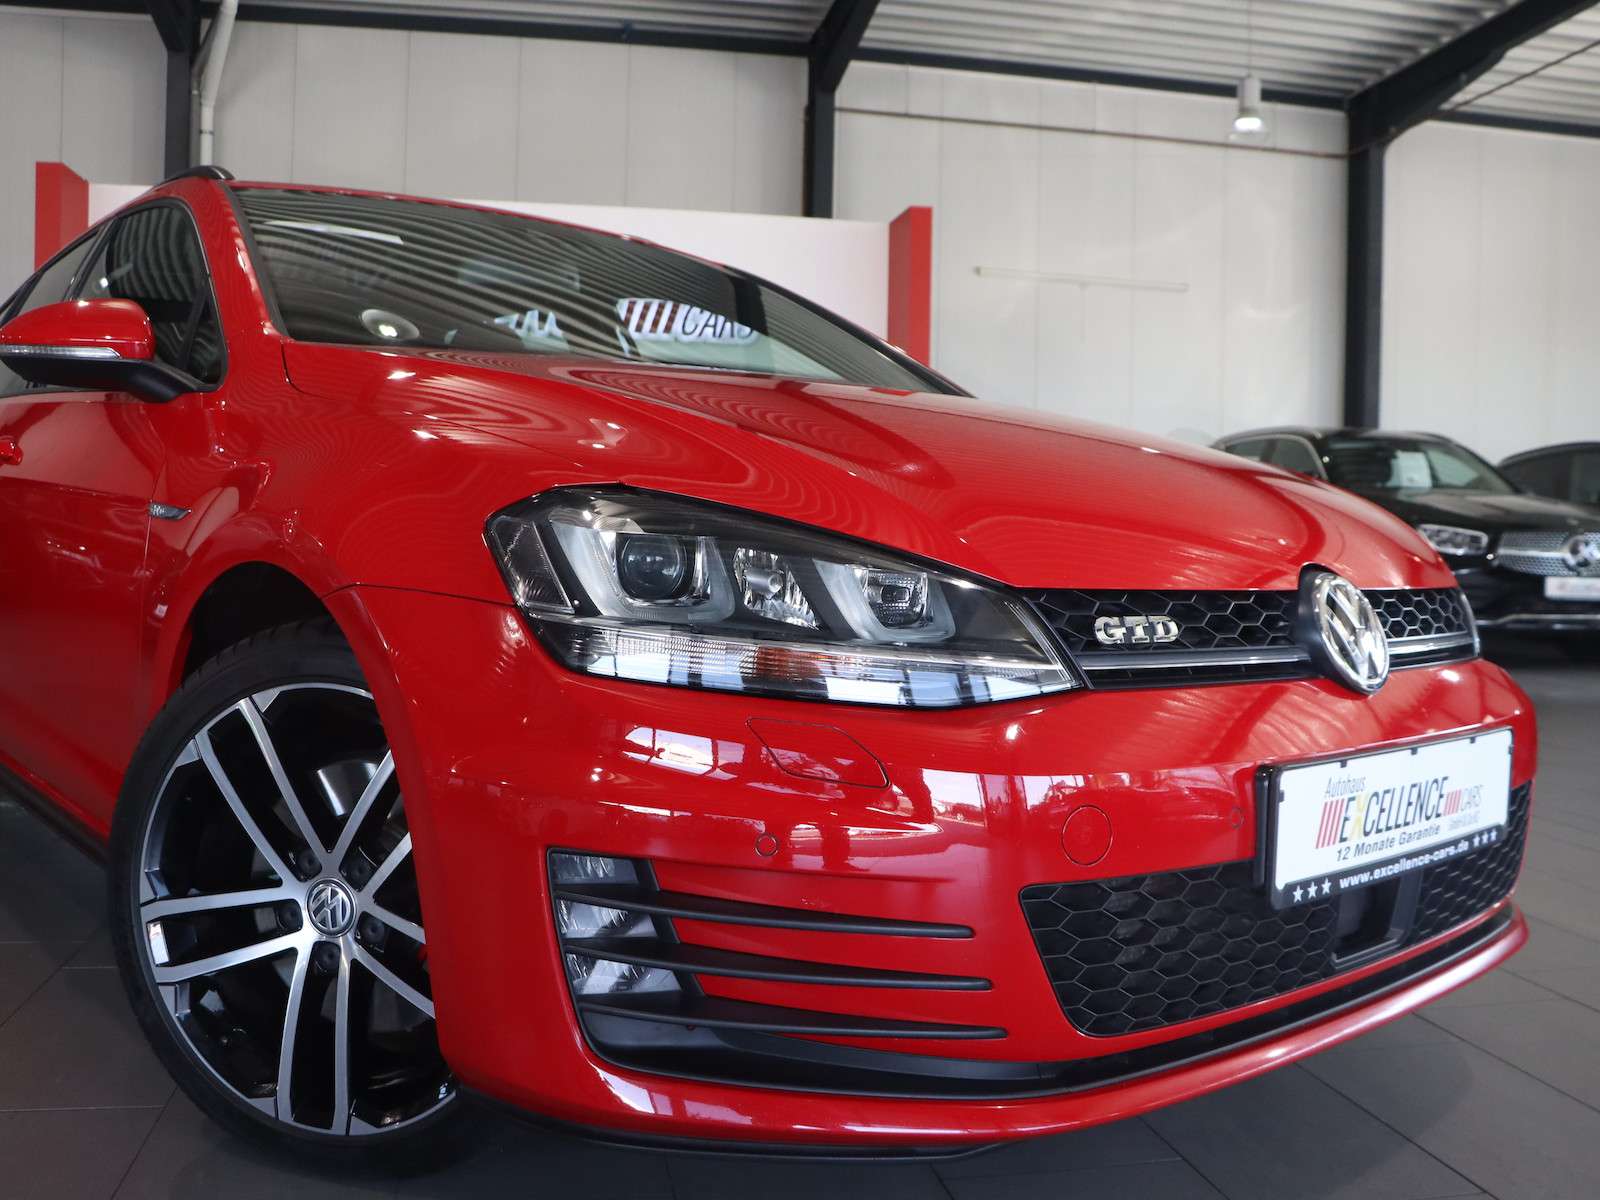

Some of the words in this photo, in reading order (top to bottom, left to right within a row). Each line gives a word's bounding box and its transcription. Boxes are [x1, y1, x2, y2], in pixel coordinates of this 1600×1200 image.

[1094, 615, 1179, 645] GTD
[1325, 774, 1366, 798] Autohaus
[1338, 776, 1449, 844] EXCELLENCE
[1336, 847, 1351, 861] 12
[1353, 837, 1396, 857] Monate
[1398, 823, 1441, 845] Garantie
[1338, 839, 1469, 889] www.excellence-cars.de
